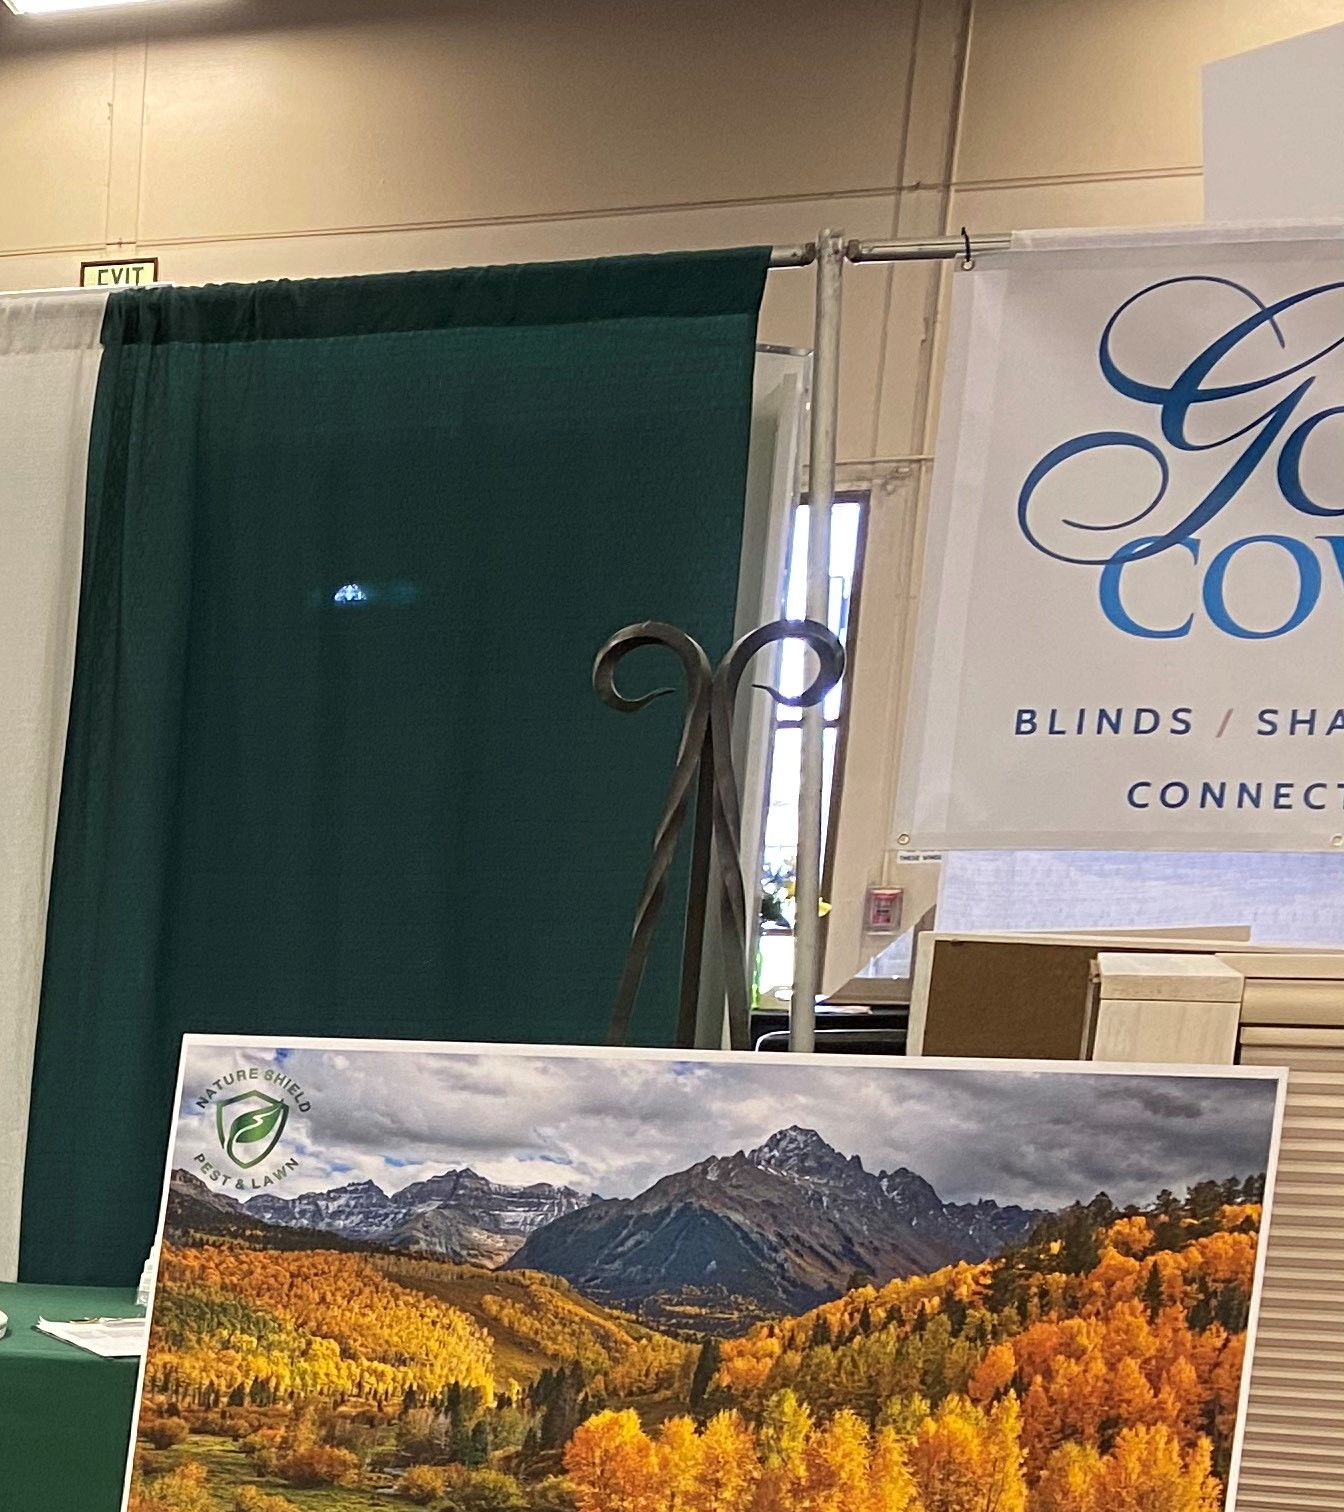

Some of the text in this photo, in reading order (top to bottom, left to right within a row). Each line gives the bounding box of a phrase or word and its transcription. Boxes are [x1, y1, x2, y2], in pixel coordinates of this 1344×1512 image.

[1099, 534, 1344, 639] CO
[1014, 707, 1193, 736] BLINDS
[1127, 781, 1344, 809] CONNEC
[195, 1067, 311, 1113] NATURE SHIELD
[193, 1153, 299, 1190] PEST & LAWN
